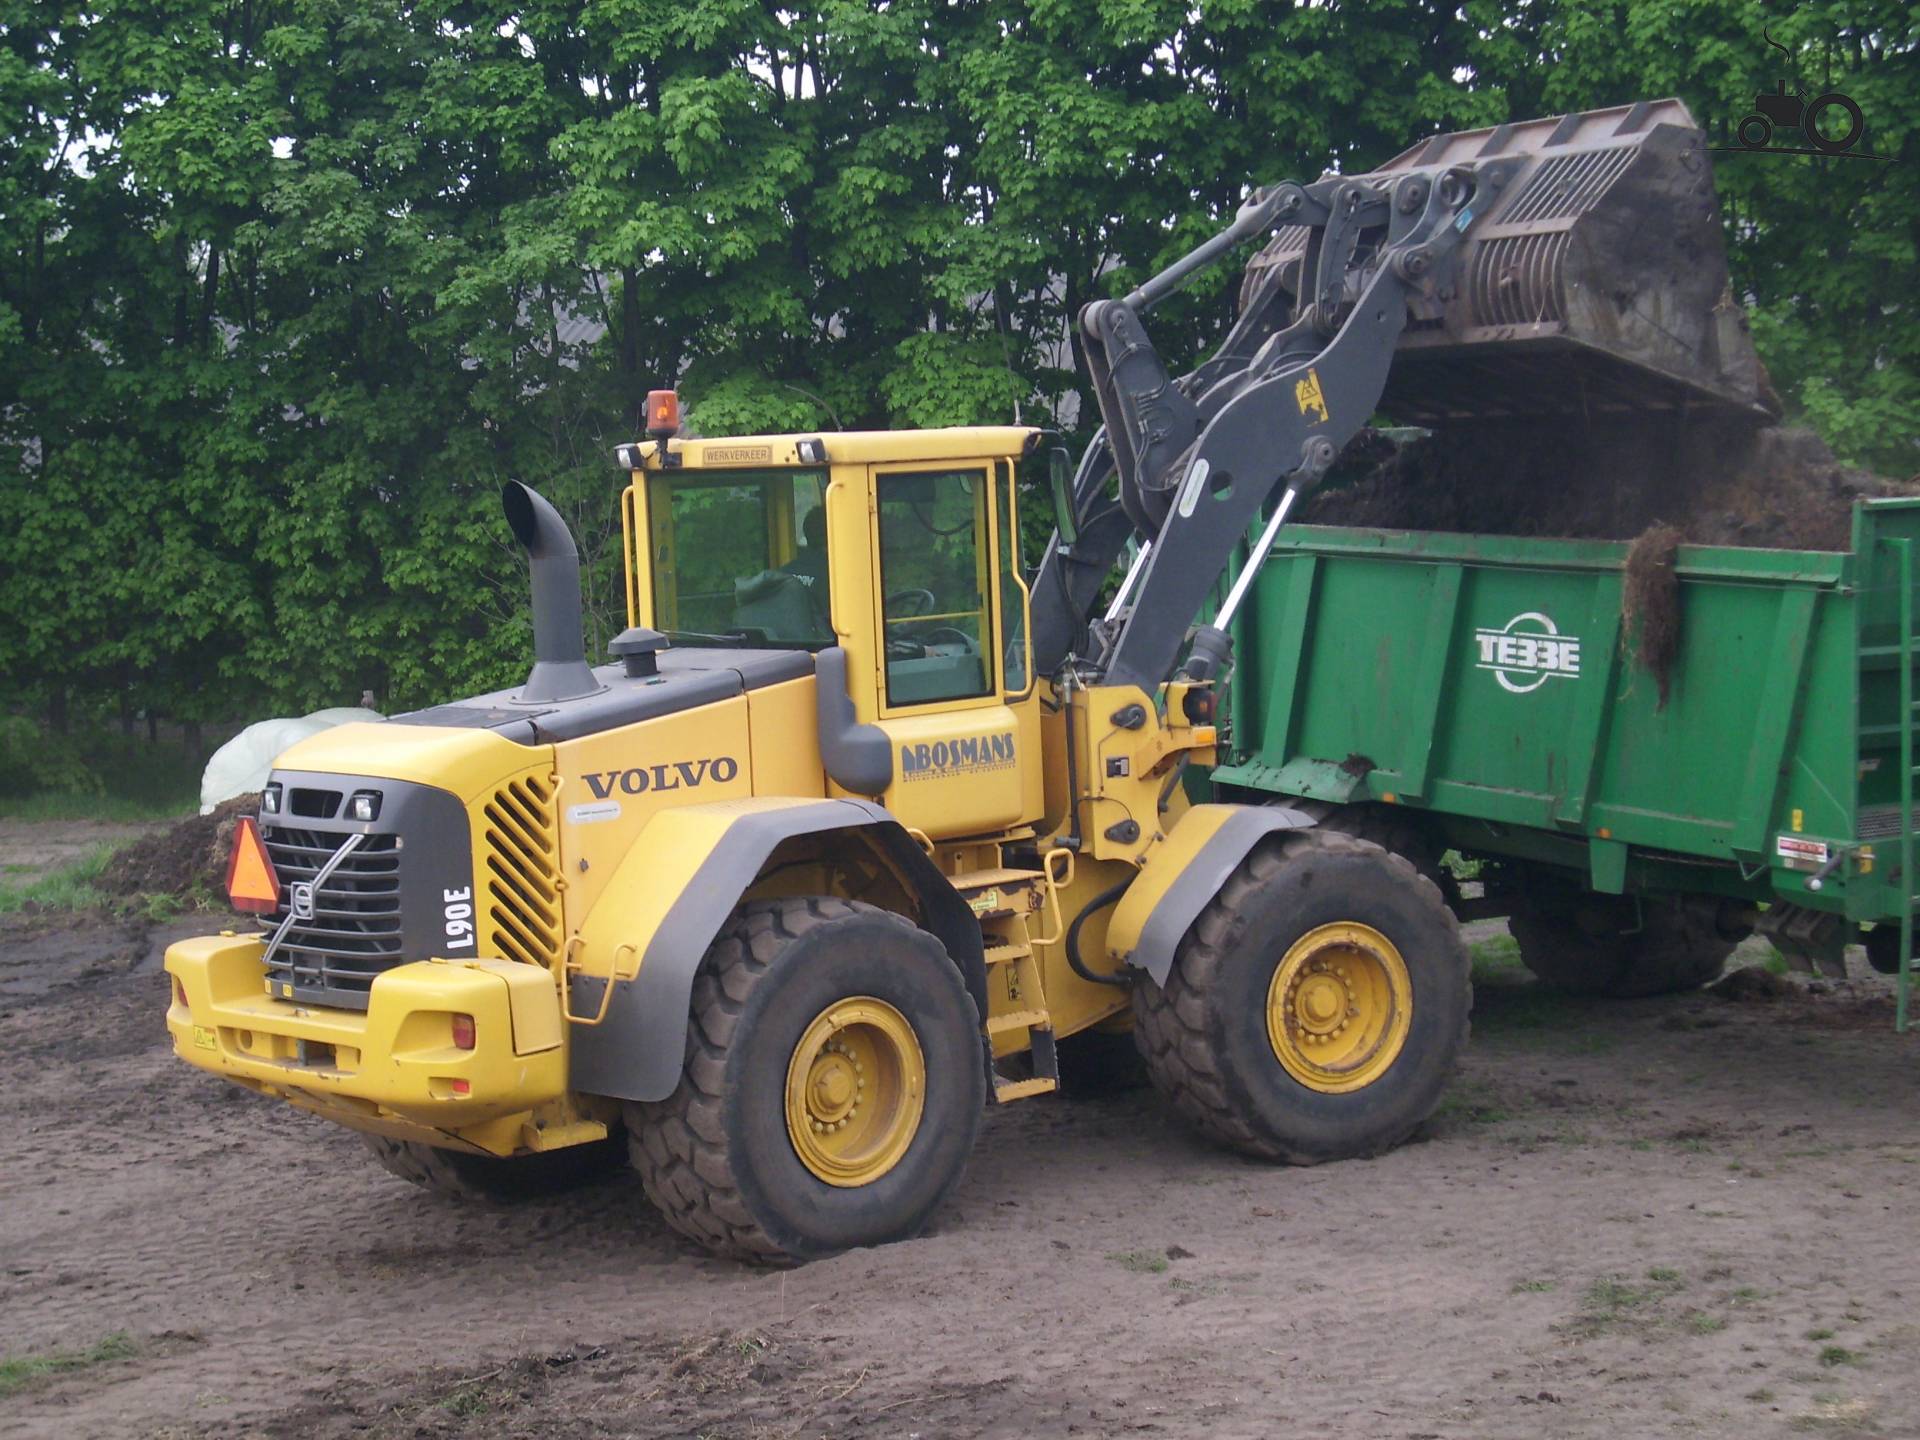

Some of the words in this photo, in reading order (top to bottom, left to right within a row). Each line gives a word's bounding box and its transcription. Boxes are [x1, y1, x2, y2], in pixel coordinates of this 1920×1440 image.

[706, 449, 767, 461] WERKVERKEER
[1476, 634, 1580, 672] TEBBE
[915, 733, 1015, 769] BOSMANS
[581, 757, 738, 799] VOLVO
[444, 886, 474, 949] L90E
